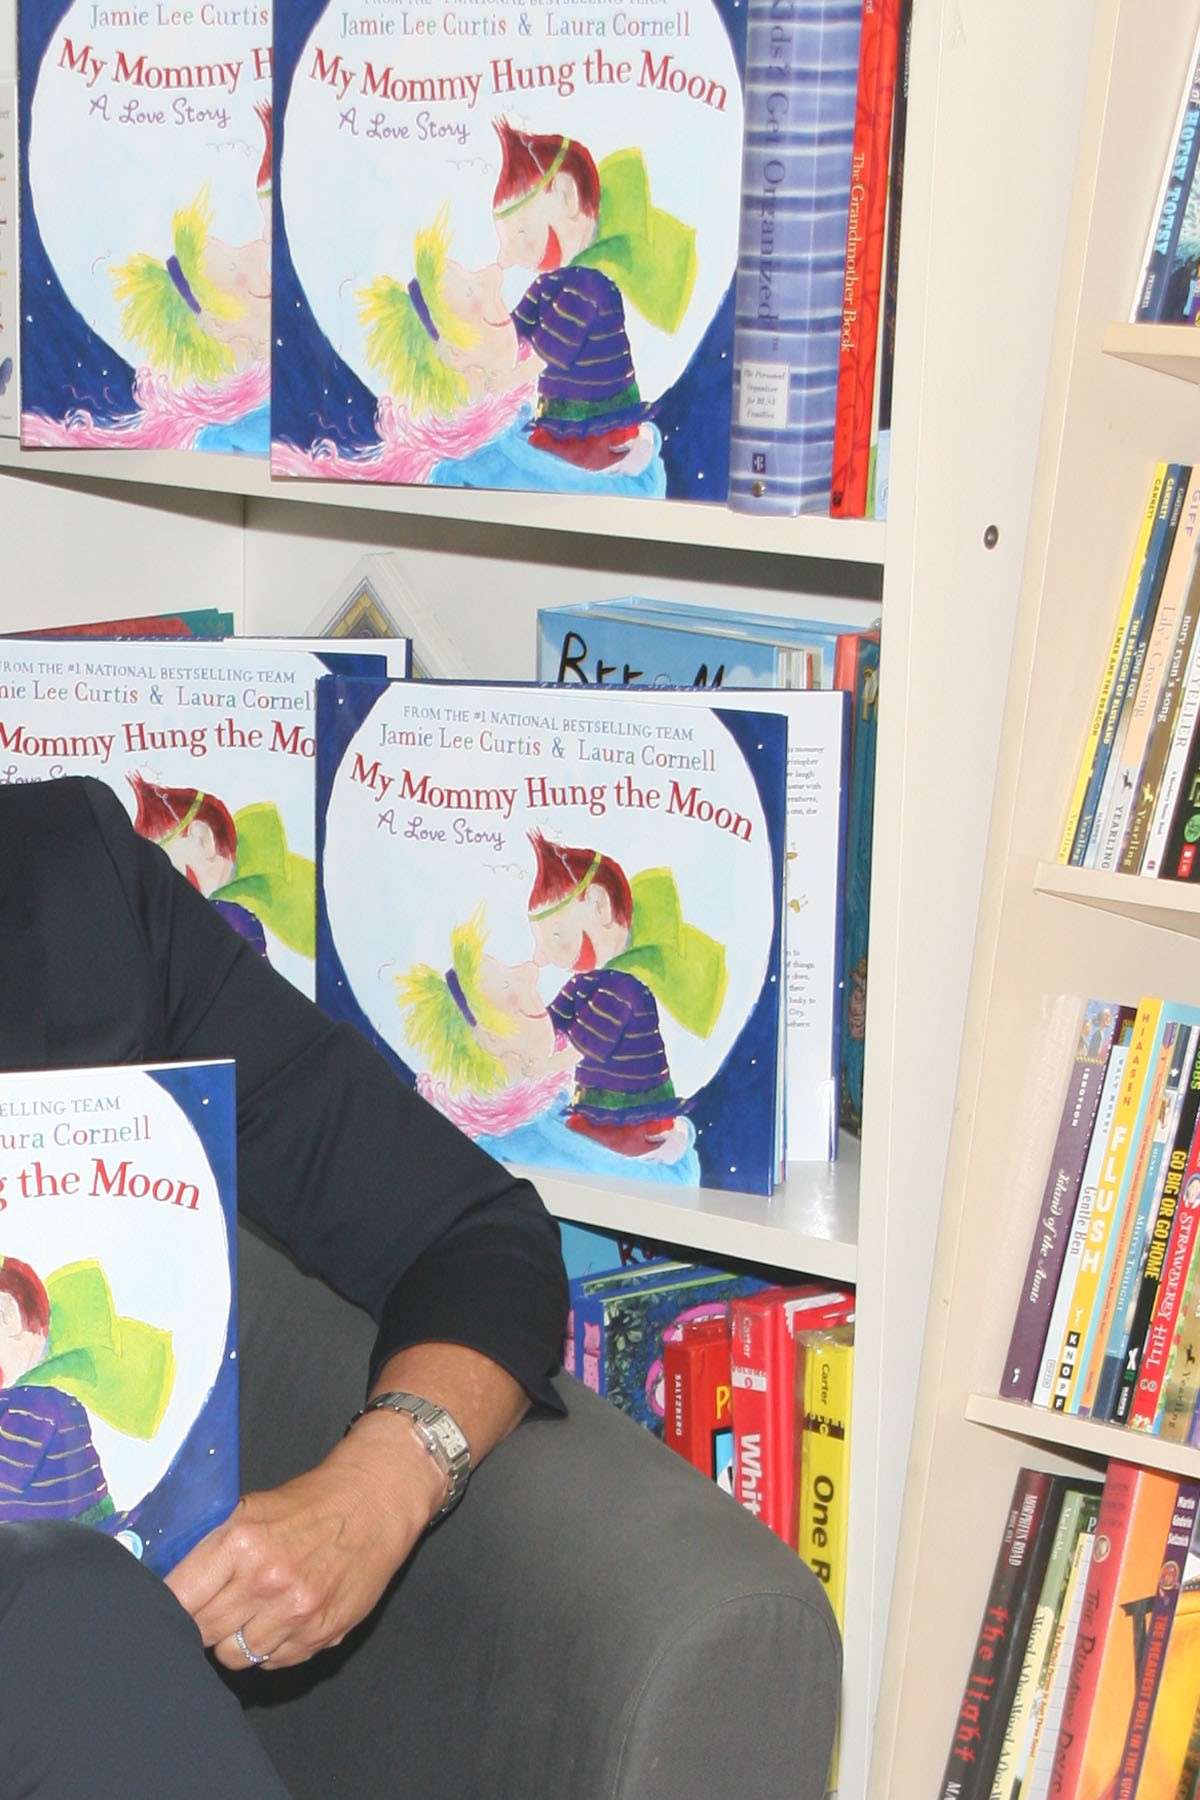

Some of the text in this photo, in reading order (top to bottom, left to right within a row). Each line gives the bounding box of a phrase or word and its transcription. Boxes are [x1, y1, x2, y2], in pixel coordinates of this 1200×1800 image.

[90, 4, 269, 29] Jamie Lee Curtis
[340, 12, 690, 39] Jamie Lee Curtis & Laura Cornell
[57, 37, 108, 88] My
[112, 51, 243, 95] Mommy
[309, 47, 356, 100] My
[359, 62, 484, 109] Mommy
[490, 57, 576, 96] Hung
[583, 49, 632, 85] the
[635, 49, 728, 112] Moon
[89, 94, 231, 129] A Love Story
[338, 107, 471, 145] A Love Story
[767, 92, 790, 143] Get
[1155, 110, 1199, 254] HOTSY TOTSY
[757, 160, 785, 321] Organized
[841, 152, 865, 353] The Grandmother Book
[33, 680, 68, 701] Lee
[75, 681, 139, 704] Curtis
[149, 686, 164, 705] &
[177, 686, 236, 708] Laura
[38, 662, 63, 675] THE
[68, 663, 81, 675] #1
[85, 664, 157, 680] NATIONAL
[160, 667, 253, 683] BESTSELLING
[257, 671, 295, 684] TEAM
[122, 722, 207, 756] Hung
[216, 717, 263, 749] the
[269, 720, 317, 758] Mo
[379, 723, 716, 772] Jamie Lee Curtis & Laura Cornell
[403, 705, 694, 742] FROM THE #1 NATIONAL BESTSELLING TEAM
[348, 752, 395, 802] My
[397, 769, 519, 820] Mommy
[524, 776, 607, 817] Hung
[613, 775, 661, 810] the
[665, 780, 754, 844] Moon
[377, 808, 507, 851] A Love Story
[1101, 806, 1123, 868] YEARLING
[1123, 1013, 1150, 1106] HIAASEN
[71, 1096, 121, 1113] TEAM
[1072, 1068, 1091, 1127] IBBOTSON
[53, 1116, 152, 1147] Cornell
[17, 1162, 82, 1199] the
[87, 1158, 202, 1211] Moon
[1081, 1126, 1127, 1275] FLUSH
[1070, 1184, 1097, 1255] Gentle Ben
[1144, 1151, 1187, 1280] GO BIG OR GO HOME
[1145, 1212, 1193, 1369] STRAWBERRY HILL
[820, 1364, 830, 1405] Carter
[814, 1475, 834, 1548] One
[1017, 1494, 1037, 1543] MORPHEUS
[1009, 1540, 1025, 1566] ROAD
[955, 1606, 1009, 1763] the light
